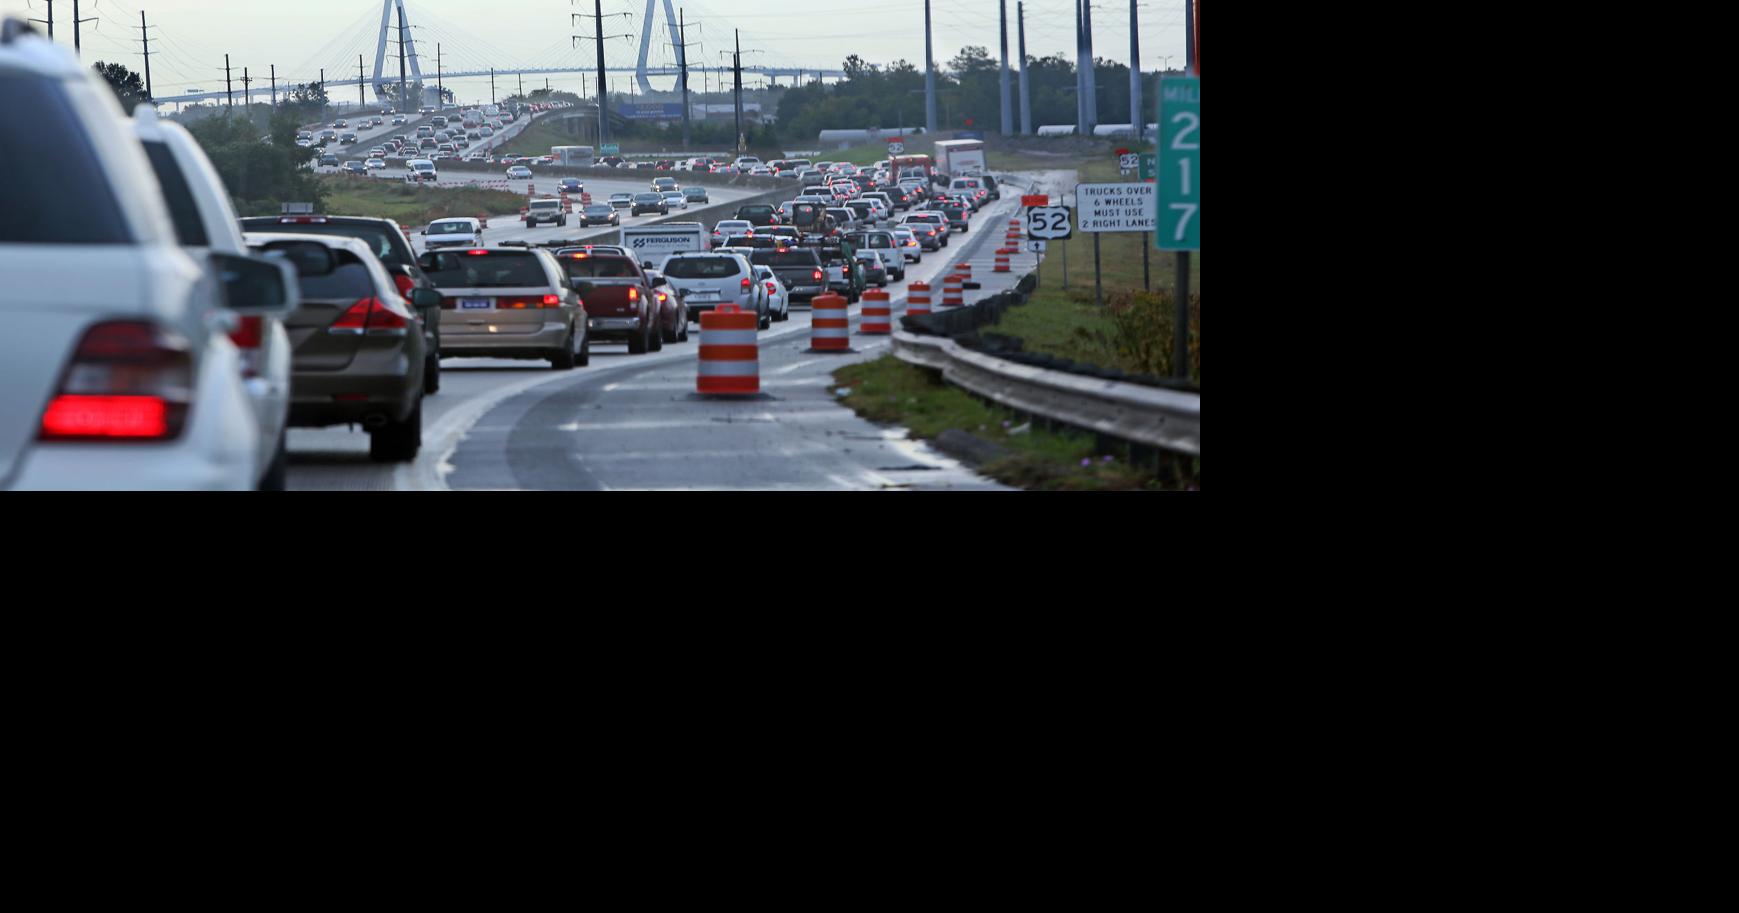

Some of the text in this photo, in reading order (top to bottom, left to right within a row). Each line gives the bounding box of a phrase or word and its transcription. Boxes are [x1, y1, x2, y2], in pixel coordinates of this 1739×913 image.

[1164, 86, 1200, 102] MIL
[1121, 155, 1138, 166] 52
[1085, 186, 1152, 196] TRUCKS OVER
[1105, 198, 1143, 206] WHEELS
[1094, 208, 1144, 217] MUST USE
[1032, 212, 1067, 231] 52
[1082, 220, 1089, 228] 2
[1093, 219, 1120, 228] RIGHT
[646, 236, 690, 244] FERGUSON
